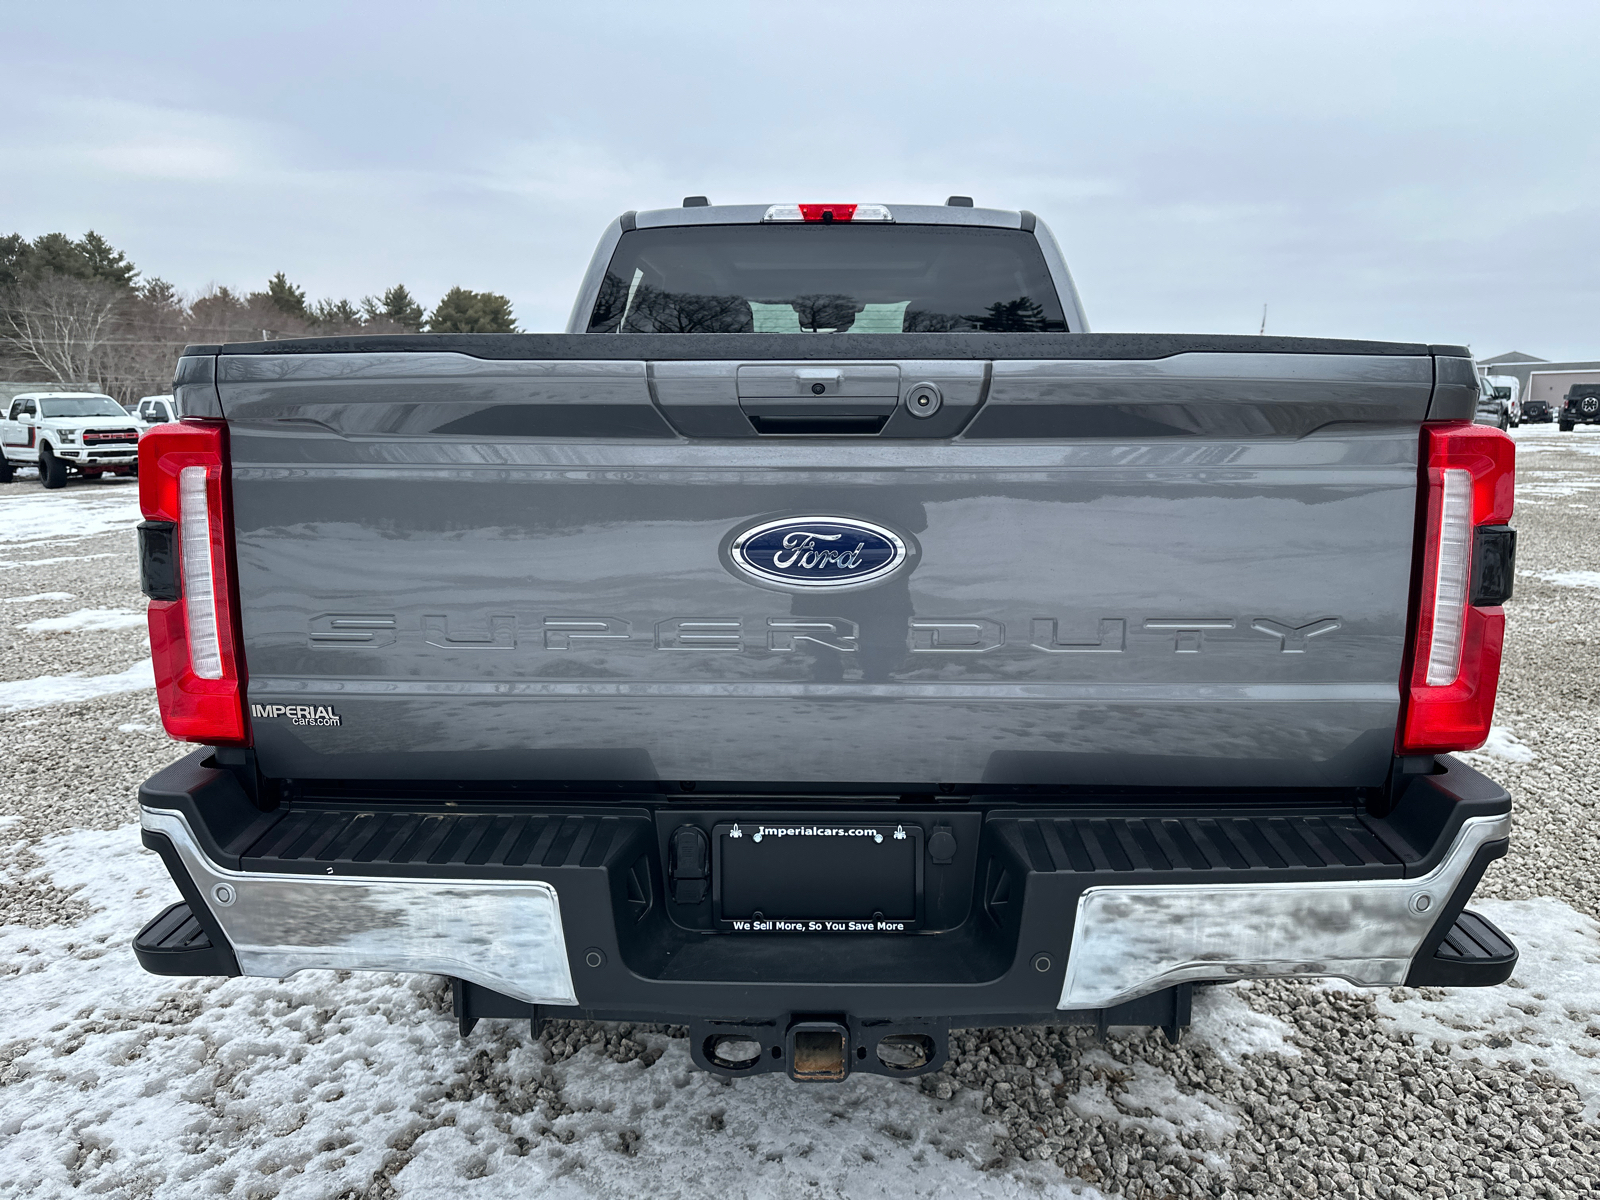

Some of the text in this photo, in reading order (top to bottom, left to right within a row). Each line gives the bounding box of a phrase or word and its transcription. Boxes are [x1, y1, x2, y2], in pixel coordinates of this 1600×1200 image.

[773, 531, 865, 569] Ford
[308, 612, 1342, 654] SUPER DUTY
[251, 704, 340, 719] IMPERIAL
[292, 717, 340, 726] cars.com
[758, 826, 877, 837] Imperialcars.com
[733, 921, 904, 932] We Sell More, So You Save More
